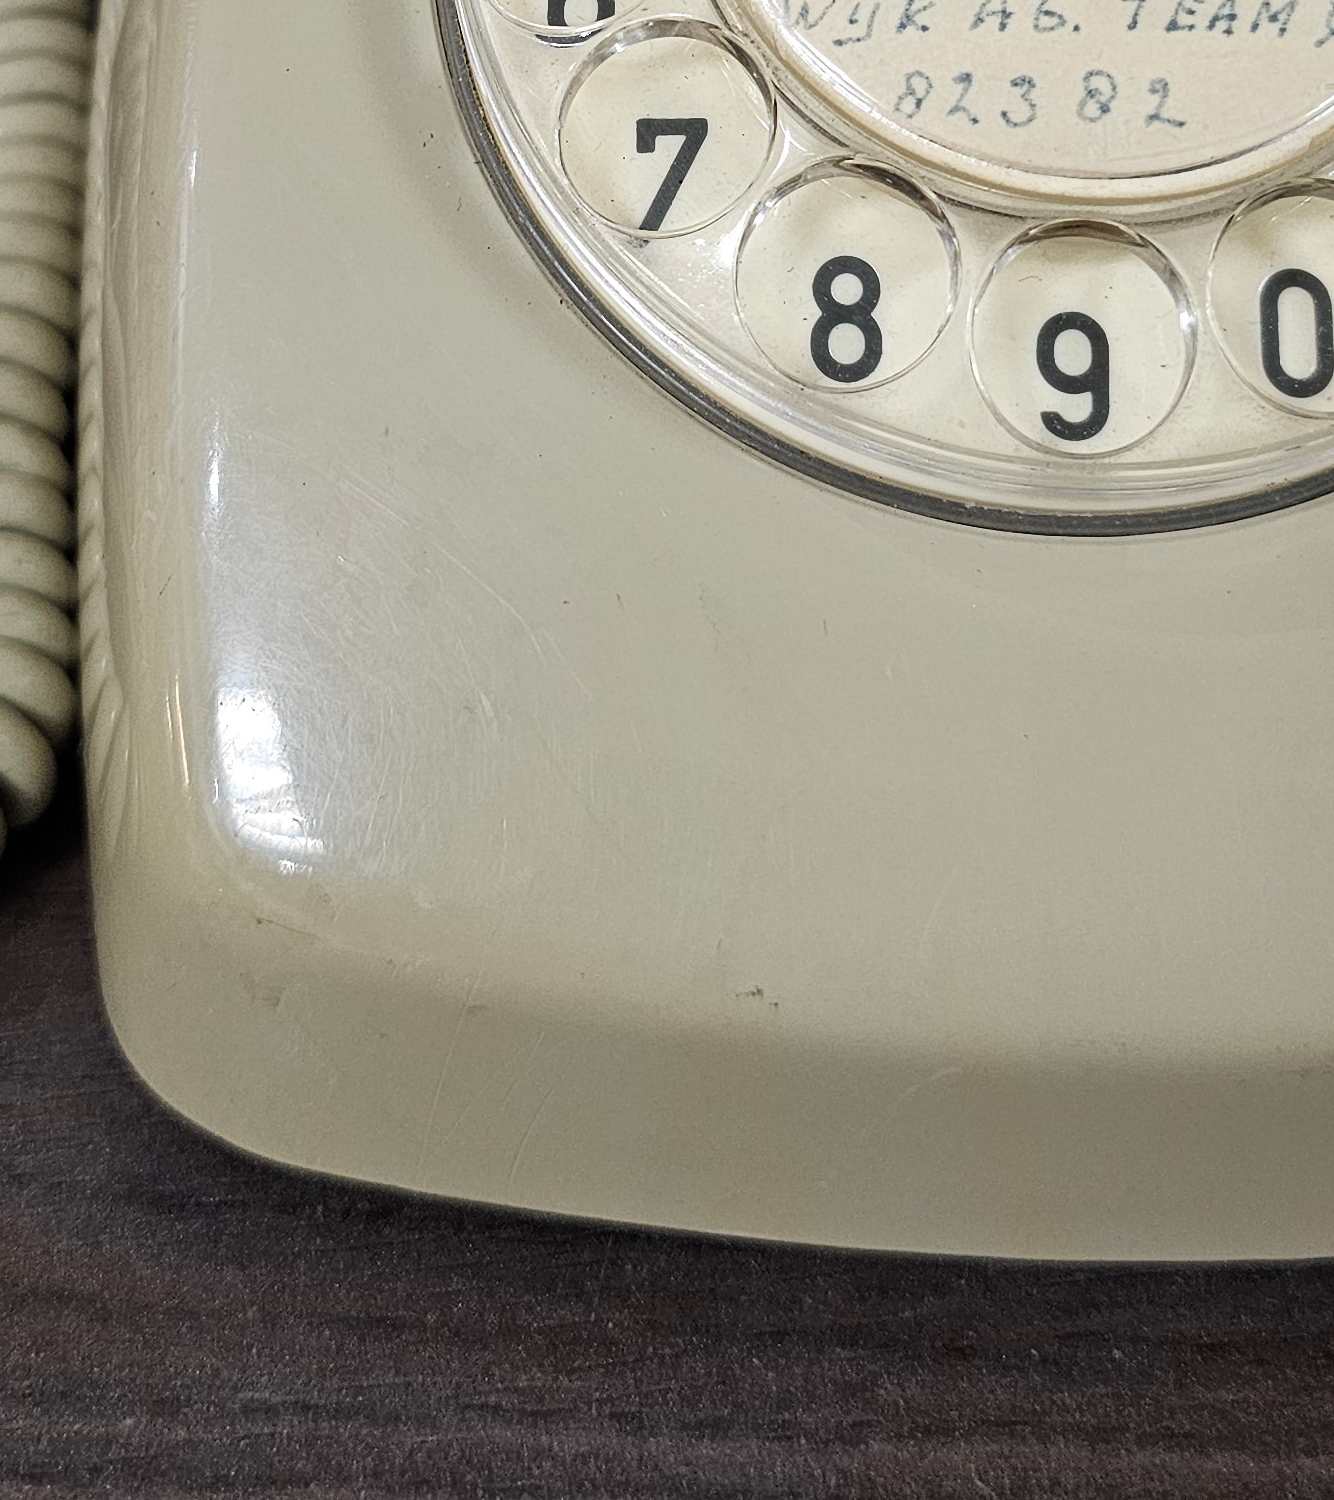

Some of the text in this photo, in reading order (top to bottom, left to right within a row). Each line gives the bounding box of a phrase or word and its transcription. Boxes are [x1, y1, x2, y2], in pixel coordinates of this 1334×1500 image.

[894, 69, 1188, 128] 82382
[635, 117, 709, 246] 7
[810, 255, 883, 384] 8
[1036, 311, 1110, 442] 9
[1259, 267, 1334, 399] 0
